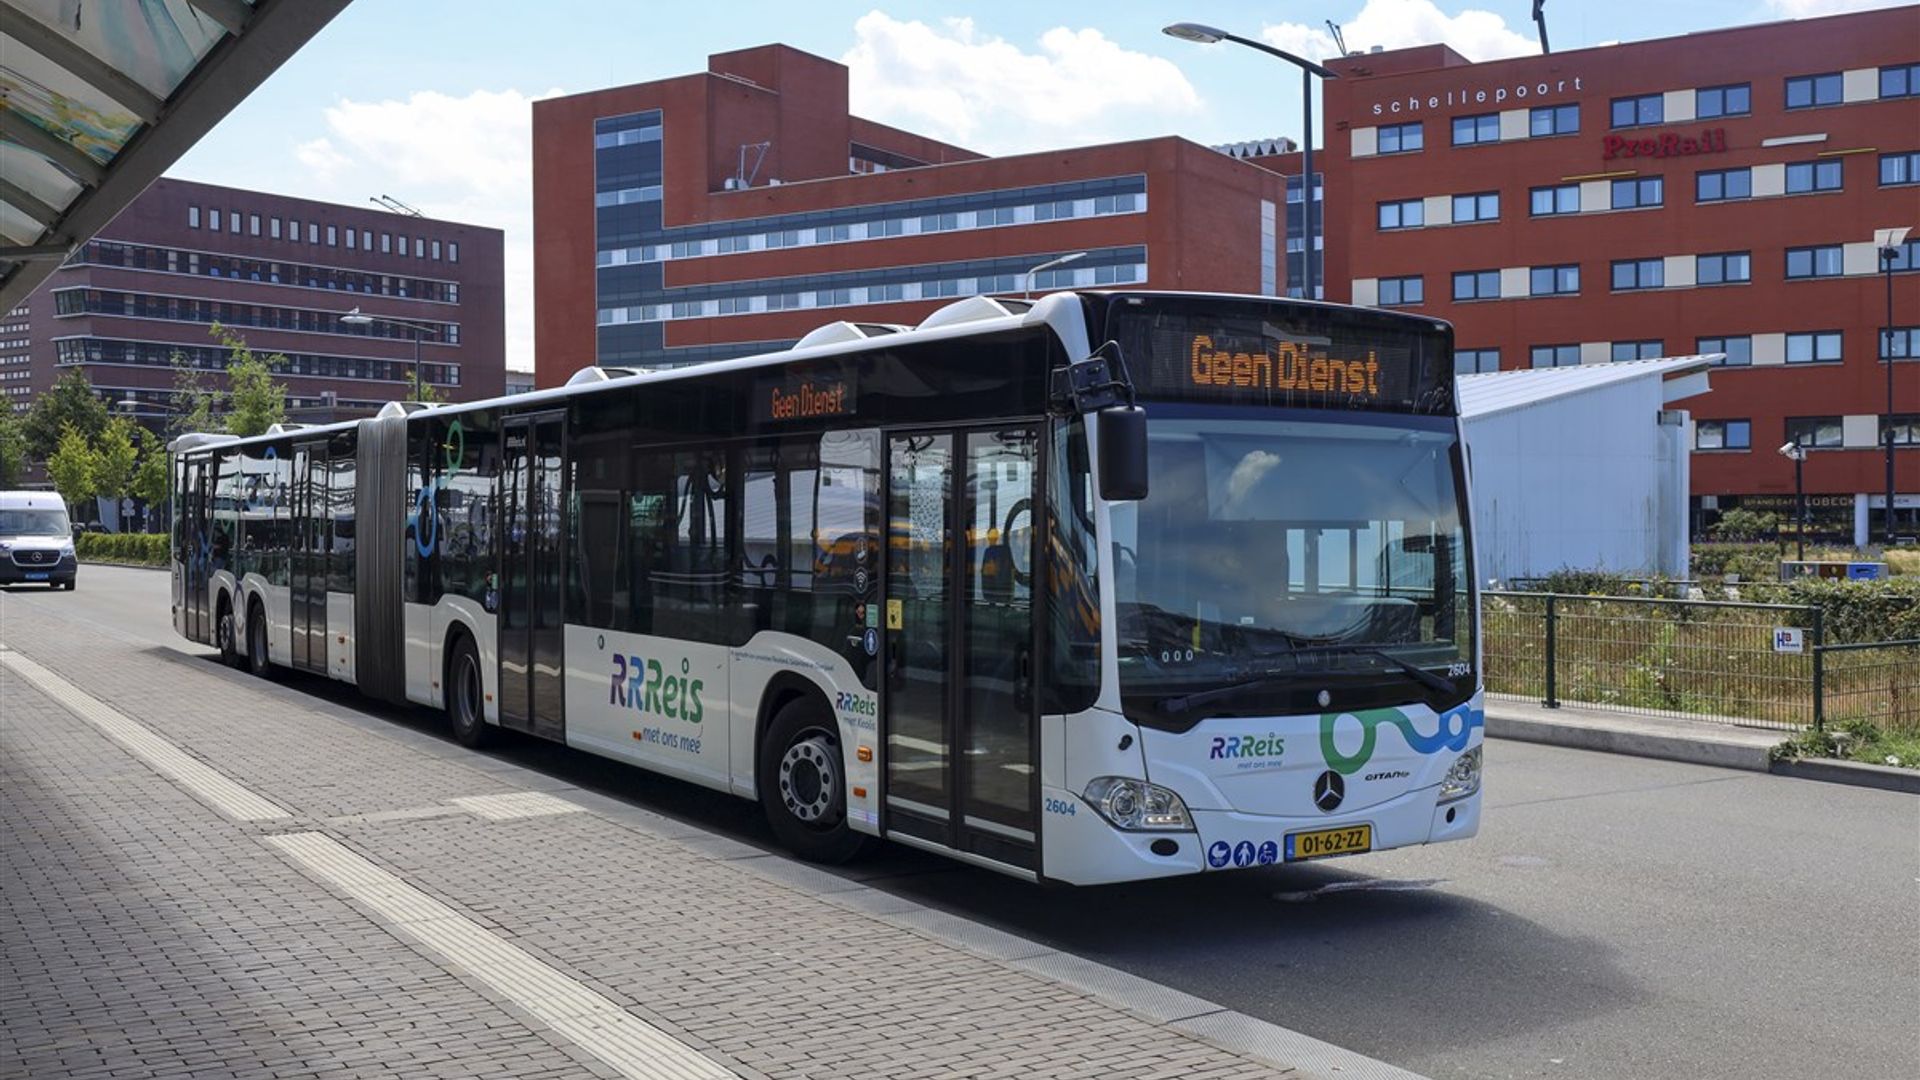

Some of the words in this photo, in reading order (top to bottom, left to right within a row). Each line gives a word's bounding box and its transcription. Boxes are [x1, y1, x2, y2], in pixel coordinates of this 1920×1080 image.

[1373, 77, 1582, 114] schellepoort
[1602, 128, 1727, 160] ProRail
[1192, 335, 1272, 388] Geen
[1278, 341, 1378, 394] Dienst
[772, 387, 800, 418] Geen
[801, 382, 843, 416] Dienst
[1448, 663, 1471, 677] 2604
[610, 653, 704, 724] RRReis
[836, 691, 877, 717] RRReis
[643, 727, 661, 743] met
[662, 732, 679, 749] ons
[680, 736, 702, 754] mee
[1210, 732, 1285, 759] RRReis
[1045, 797, 1077, 817] 2604
[1302, 830, 1364, 854] 01-62-ZZ
